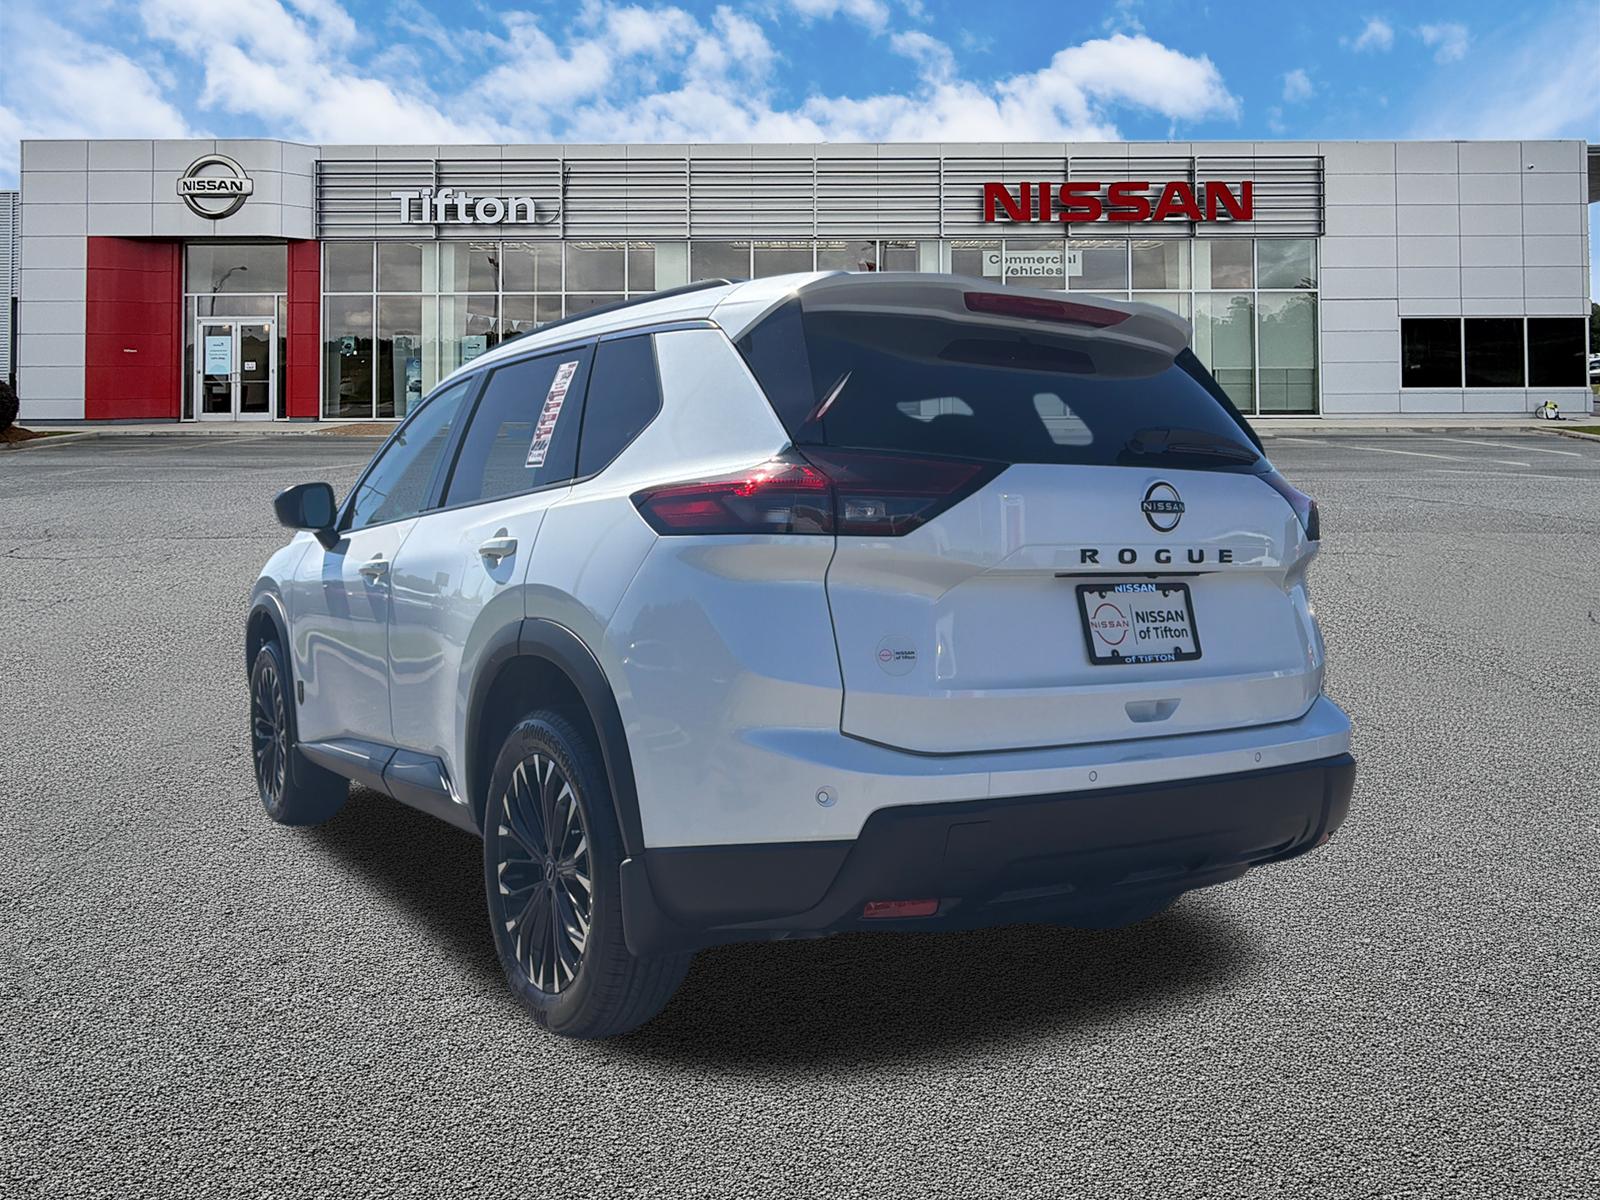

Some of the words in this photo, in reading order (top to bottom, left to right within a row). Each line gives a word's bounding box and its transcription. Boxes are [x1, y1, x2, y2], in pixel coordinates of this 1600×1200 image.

[183, 181, 243, 191] NISSAN
[391, 188, 536, 224] Tifton
[984, 181, 1253, 222] NISSAN
[1143, 502, 1185, 511] NISSAN
[1080, 548, 1233, 564] ROGUE
[1114, 583, 1157, 593] NISSAN
[1135, 610, 1185, 623] NISSAN
[1090, 620, 1129, 628] NISSAN
[1139, 627, 1151, 640] of
[1153, 627, 1189, 640] Tifton
[1125, 655, 1137, 664] of
[1139, 654, 1176, 662] TIFTON
